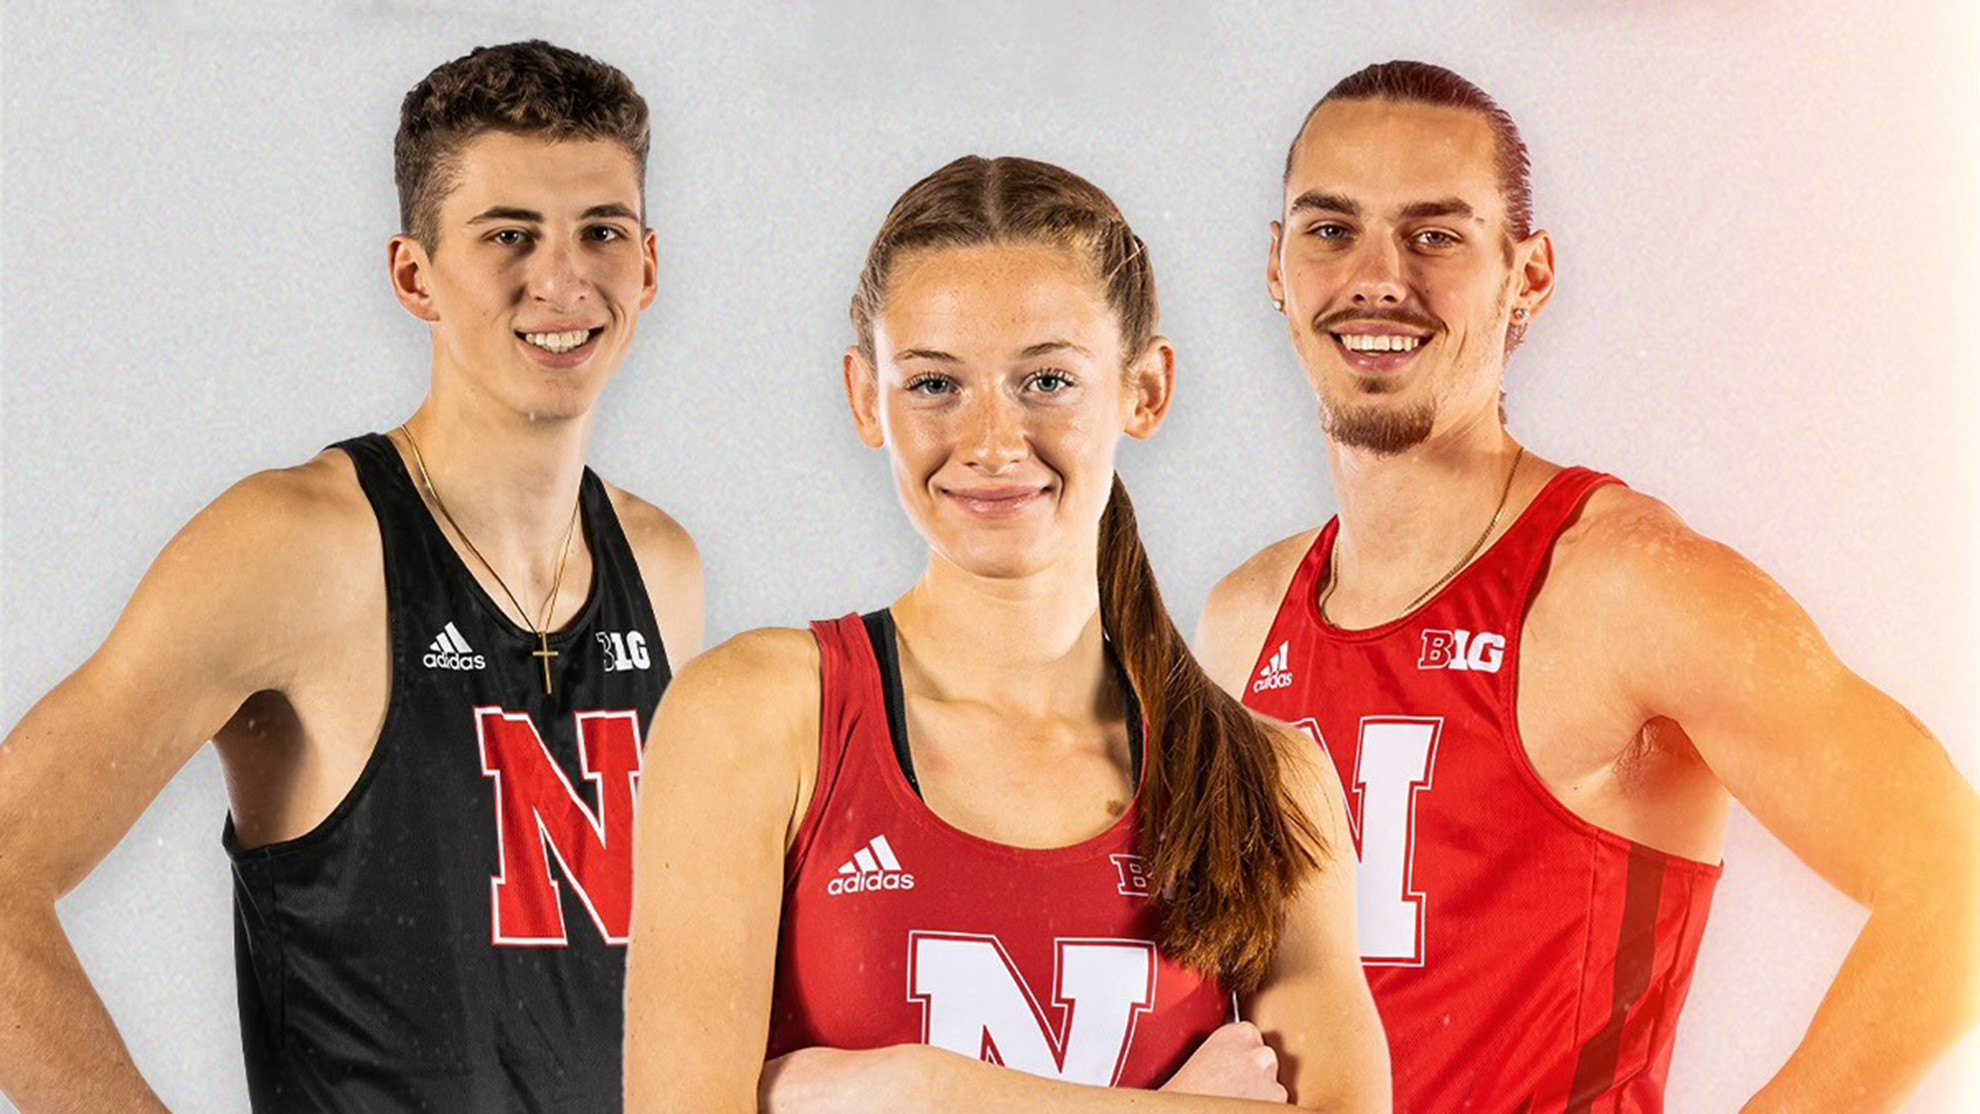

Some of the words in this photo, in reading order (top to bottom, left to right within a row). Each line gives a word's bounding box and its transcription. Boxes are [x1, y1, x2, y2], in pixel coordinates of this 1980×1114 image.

[422, 651, 486, 671] adidas
[473, 706, 644, 946] N
[827, 869, 915, 896] adidas
[906, 929, 1158, 1088] N
